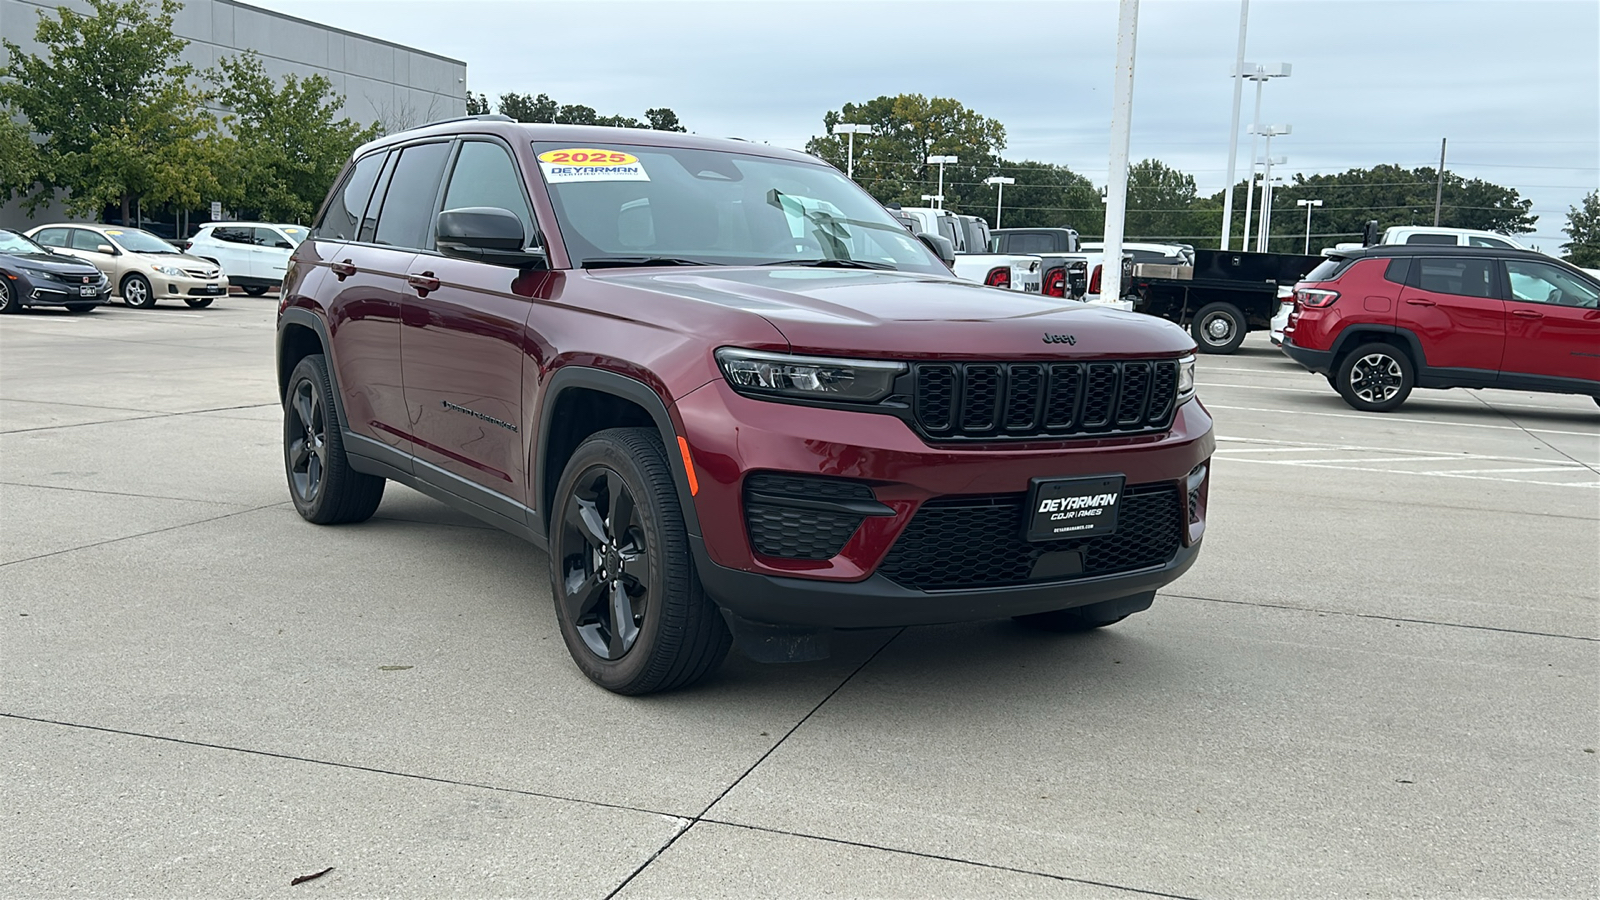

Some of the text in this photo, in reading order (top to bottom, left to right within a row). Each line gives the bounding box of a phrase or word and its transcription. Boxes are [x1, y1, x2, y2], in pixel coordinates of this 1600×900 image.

[551, 152, 626, 163] 2025
[1042, 332, 1077, 346] Jeep
[1038, 493, 1118, 513] DEYARMAN
